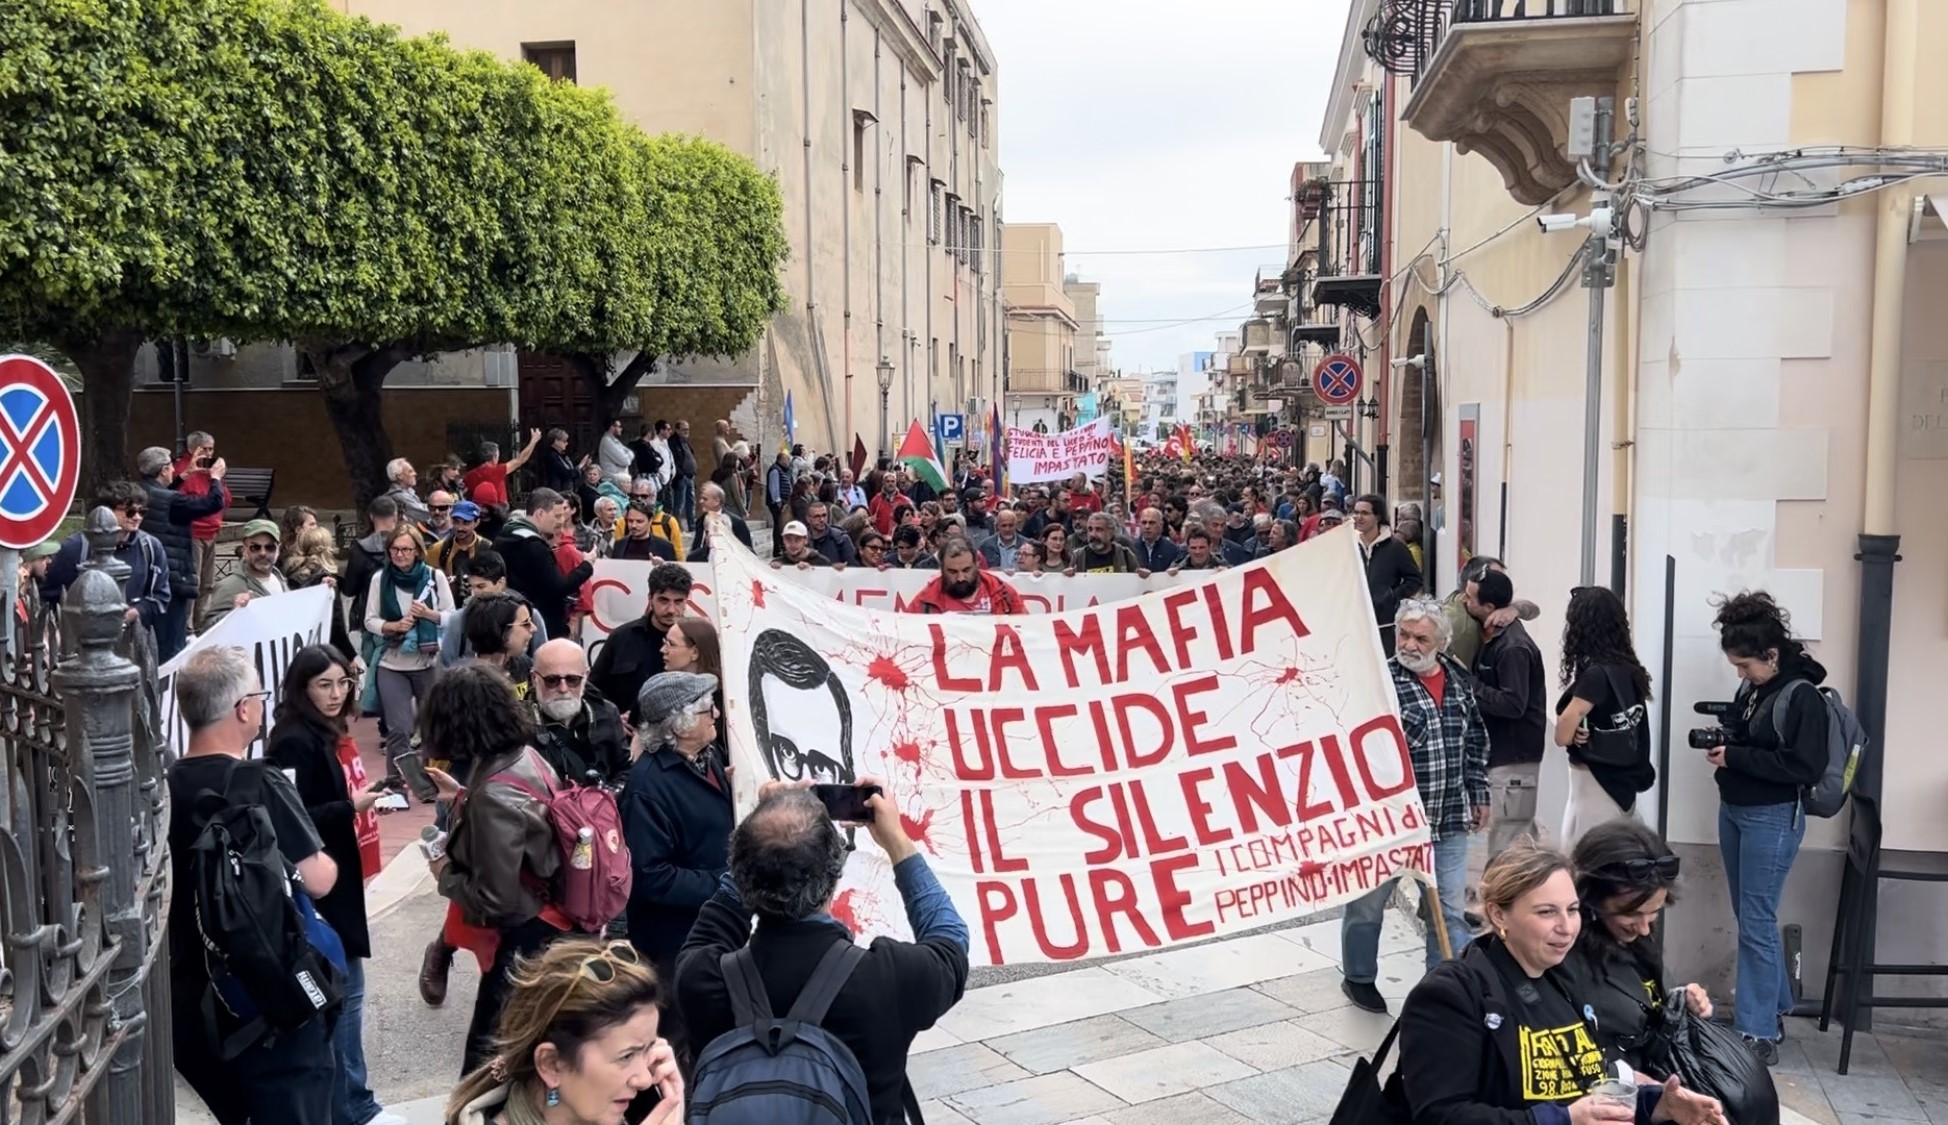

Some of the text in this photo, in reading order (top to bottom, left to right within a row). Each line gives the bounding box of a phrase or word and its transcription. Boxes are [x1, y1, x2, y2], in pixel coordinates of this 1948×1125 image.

[943, 416, 960, 437] P
[1008, 437, 1108, 459] FELICIA E PEPPINO
[1063, 436, 1085, 447] LICEO
[1034, 453, 1106, 475] IMPASTATO
[928, 567, 1311, 692] LA MAFIA
[943, 675, 1237, 781] UCCIDE
[961, 714, 1414, 873] IL SILENZIO
[1215, 849, 1226, 876] I
[1230, 808, 1396, 872] COMPAGNI
[976, 853, 1214, 965] PURE
